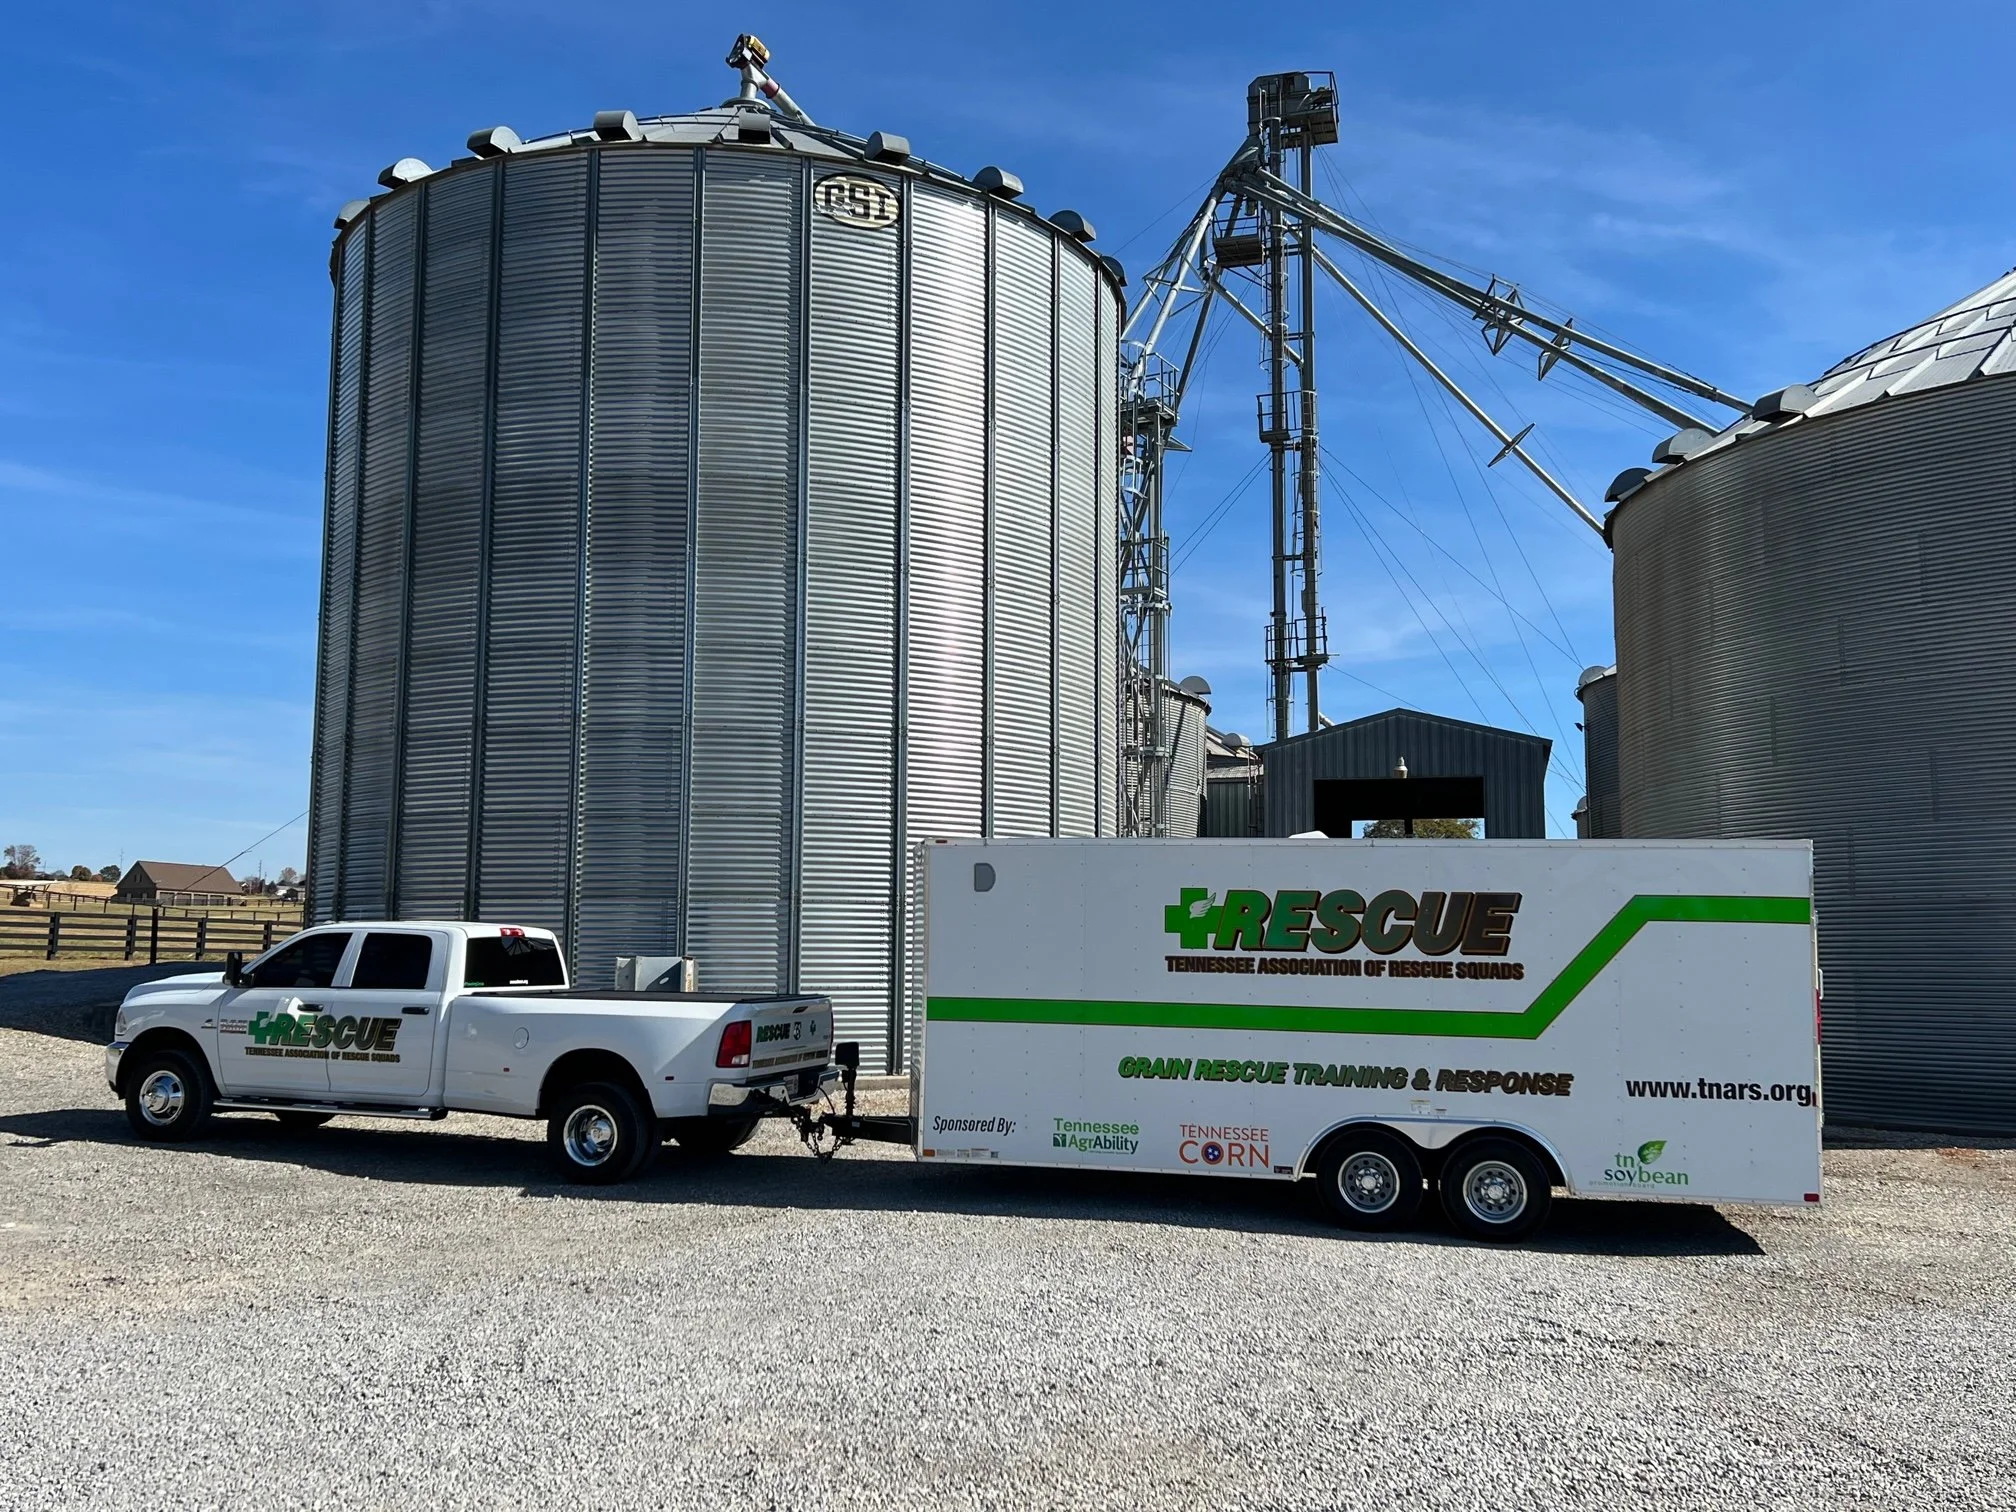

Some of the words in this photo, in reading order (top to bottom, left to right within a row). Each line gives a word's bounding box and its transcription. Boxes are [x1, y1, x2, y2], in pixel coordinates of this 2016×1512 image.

[1212, 888, 1523, 957] RESCUE
[1165, 955, 1255, 974] TENNESSEE
[1257, 957, 1362, 977] ASSOCIATION
[1363, 960, 1387, 977] OF
[1388, 960, 1454, 979] RESCUE
[1455, 962, 1525, 981] SQUADS
[267, 1012, 403, 1051] RESCUE
[756, 1023, 791, 1043] RESCUE
[245, 1046, 284, 1057] TENNESSEE
[284, 1049, 330, 1060] ASSOCIATION
[331, 1051, 341, 1060] OF
[341, 1051, 370, 1062] RESCUE
[371, 1053, 401, 1063] SQUADS
[1118, 1056, 1192, 1080] GRAIN
[1194, 1059, 1288, 1084] RESCUE
[1293, 1062, 1408, 1090] TRAINING
[1411, 1068, 1432, 1091] &
[1435, 1069, 1574, 1096] RESPONSE
[1626, 1078, 1811, 1107] www.tnars.org
[933, 1115, 996, 1134] Sponsored
[996, 1117, 1016, 1136] By:
[1053, 1117, 1139, 1135] Tennessee
[1180, 1124, 1269, 1142] TENNESSEE
[1068, 1134, 1139, 1155] AgrAbility
[1179, 1140, 1269, 1168] CORN
[1614, 1152, 1635, 1168] tn
[1604, 1166, 1689, 1186] soybean
